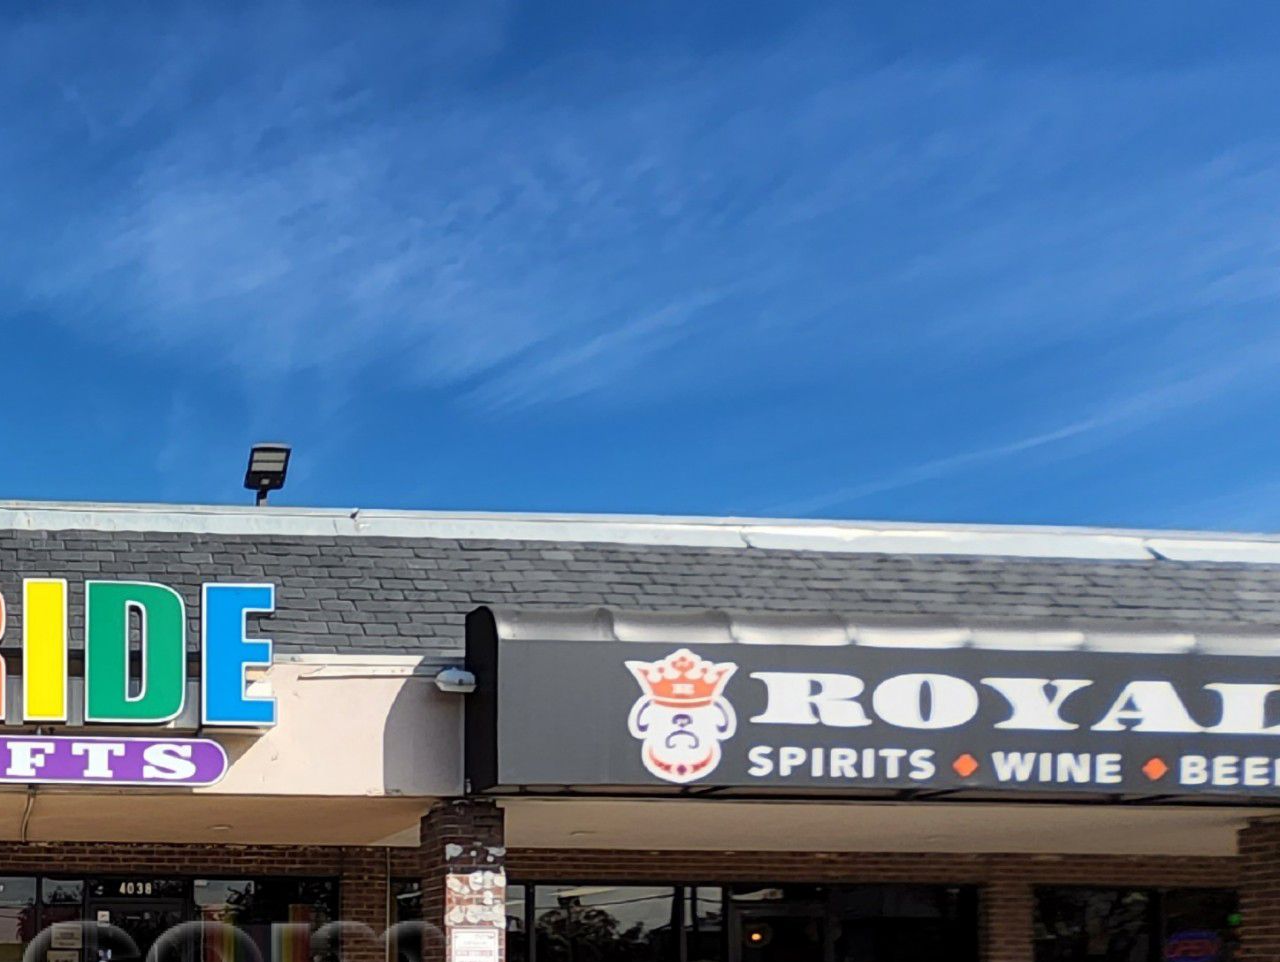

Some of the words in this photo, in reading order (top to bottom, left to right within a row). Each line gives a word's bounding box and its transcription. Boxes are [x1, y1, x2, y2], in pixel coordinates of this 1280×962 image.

[749, 671, 1280, 734] ROYAL
[748, 745, 936, 780] SPIRITS
[992, 751, 1122, 784] WINE
[1179, 755, 1280, 787] BEE
[119, 881, 152, 895] 4038
